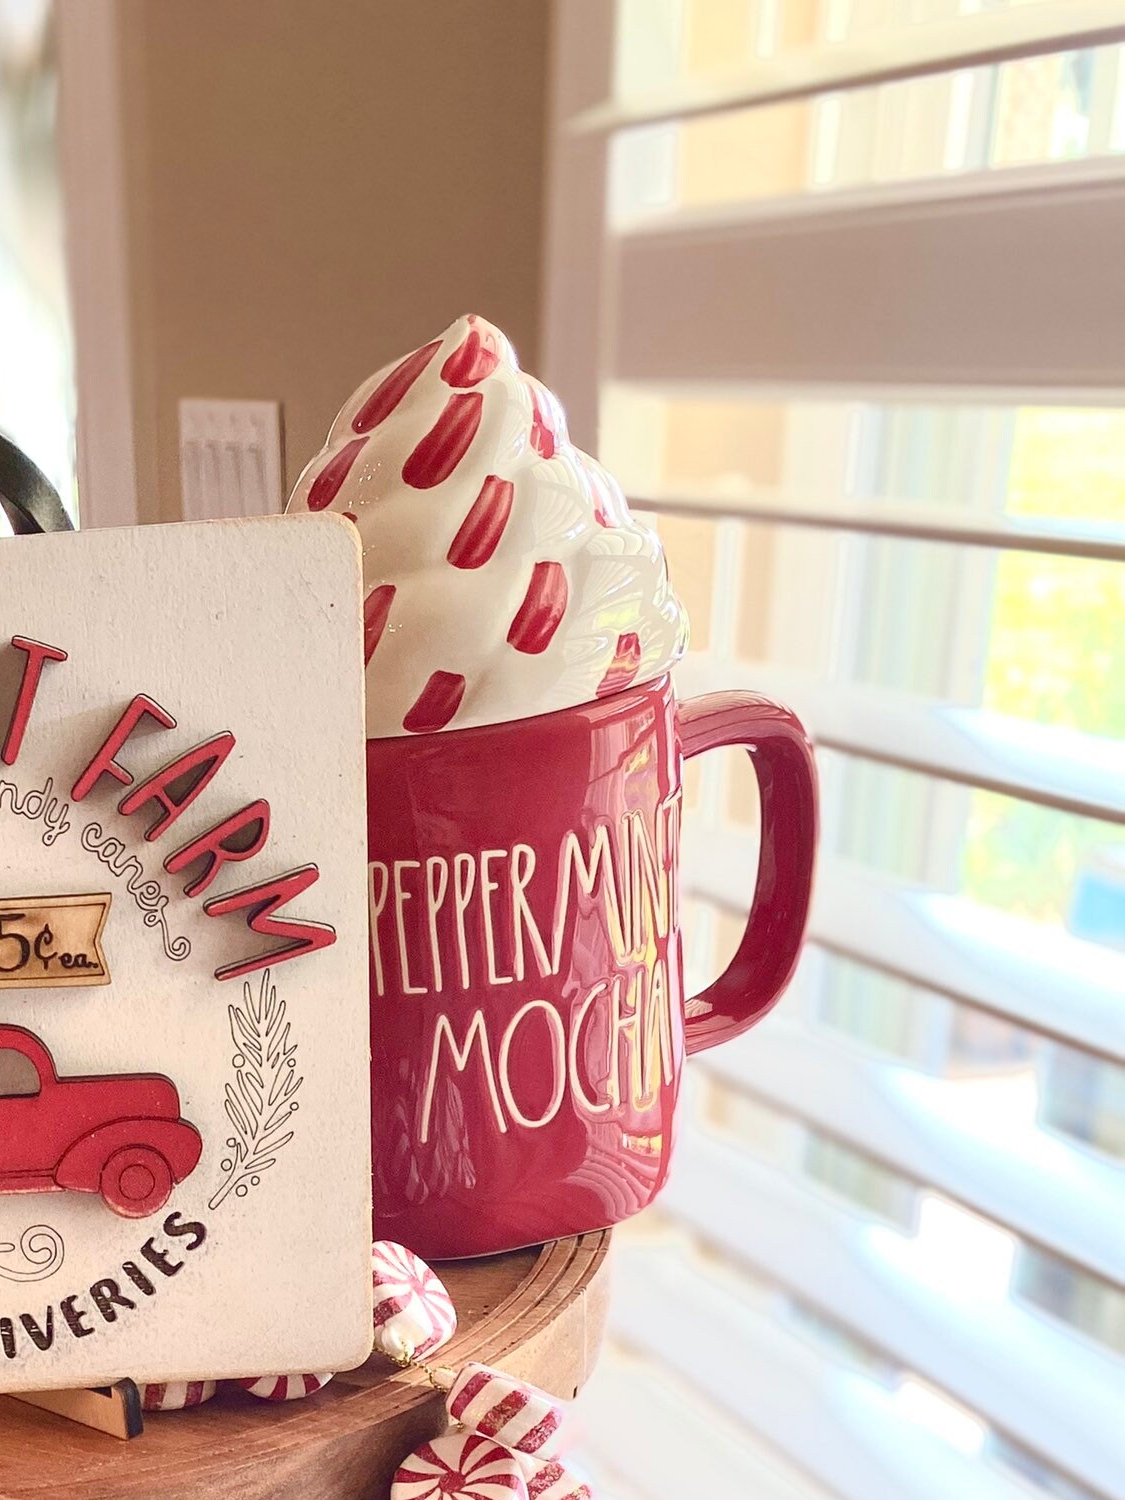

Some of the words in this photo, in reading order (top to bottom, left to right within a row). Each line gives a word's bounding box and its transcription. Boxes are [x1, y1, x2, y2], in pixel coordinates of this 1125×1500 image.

[73, 693, 338, 982] FARM
[81, 822, 191, 961] canes
[419, 960, 674, 1143] MOCHA
